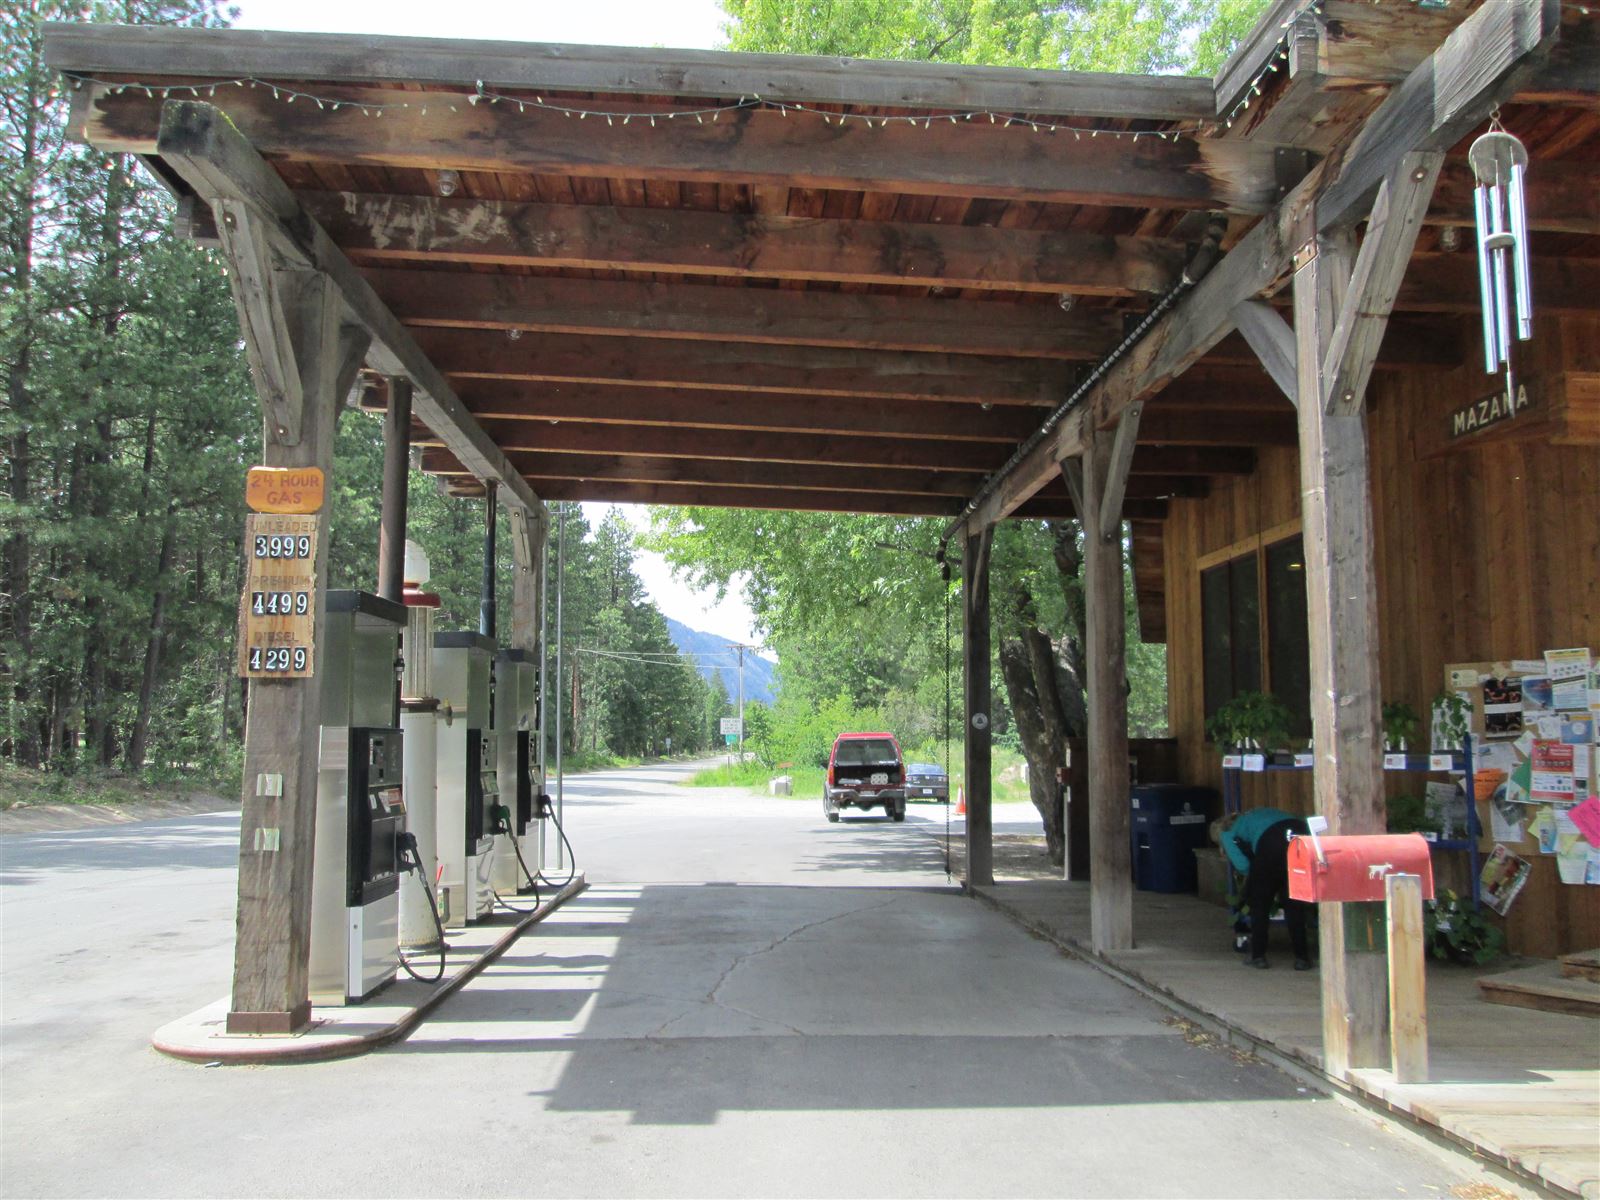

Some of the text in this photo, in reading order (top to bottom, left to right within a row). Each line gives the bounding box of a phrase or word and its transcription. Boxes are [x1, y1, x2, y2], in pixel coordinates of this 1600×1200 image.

[251, 474, 319, 488] 24 HOUR
[266, 490, 302, 504] GAS
[250, 521, 316, 532] UNLEADED
[253, 594, 307, 613] 4499
[255, 631, 299, 642] DIESEL
[250, 649, 305, 669] 4299
